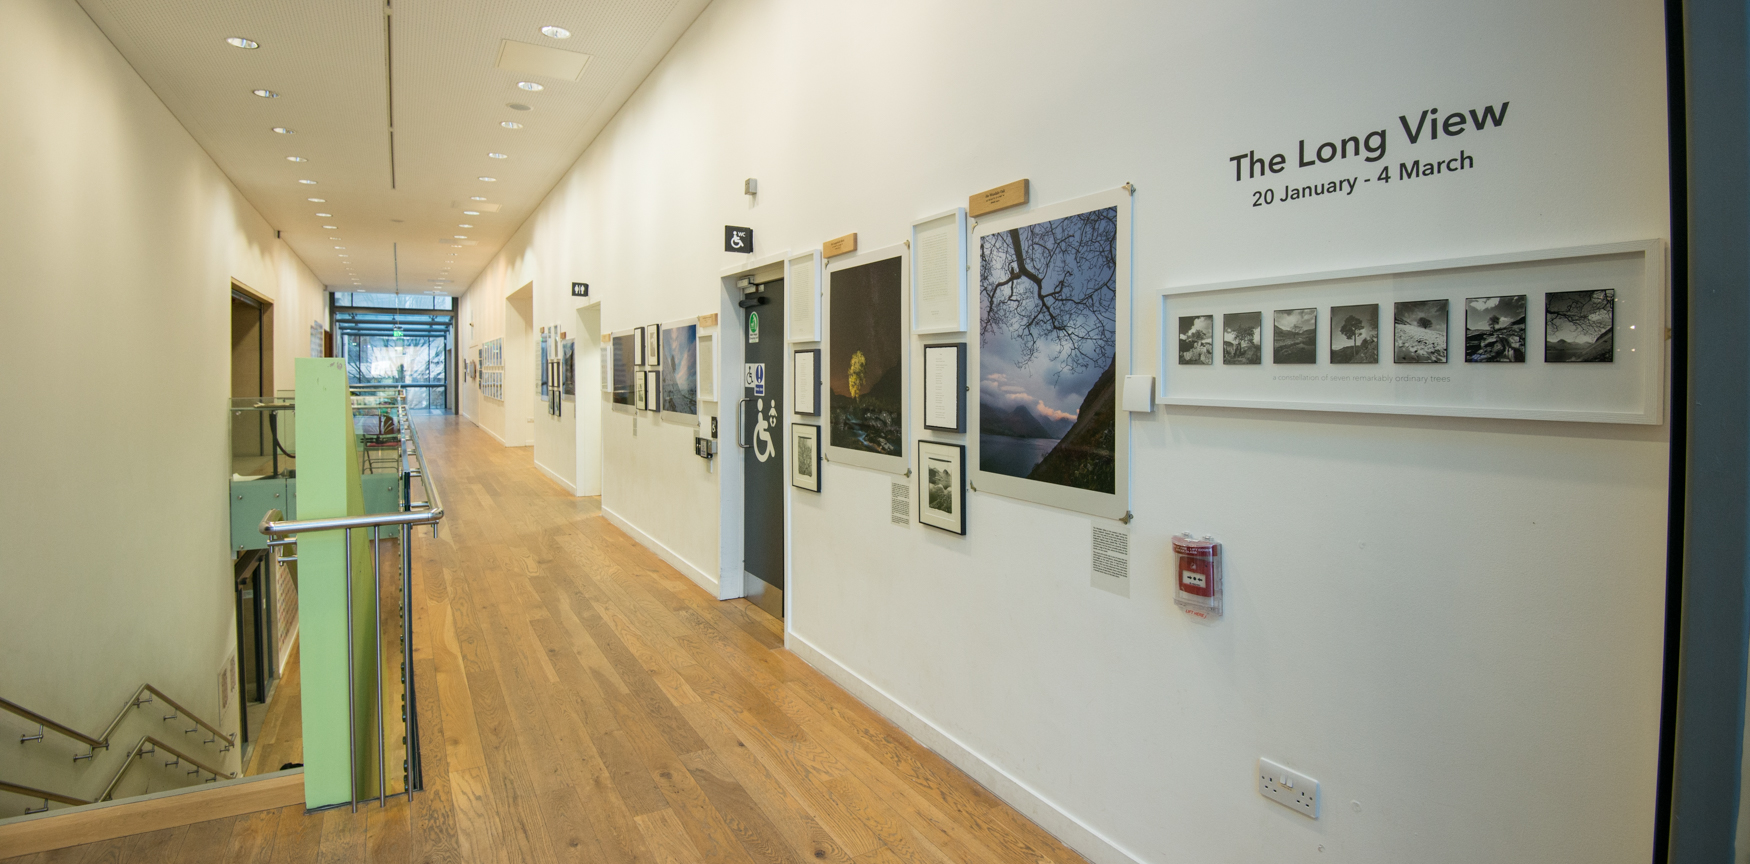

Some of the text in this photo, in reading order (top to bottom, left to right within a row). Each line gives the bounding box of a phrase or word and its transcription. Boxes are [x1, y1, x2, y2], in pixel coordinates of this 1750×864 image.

[1229, 101, 1510, 182] The Long View
[1252, 188, 1275, 207] 20
[1279, 176, 1358, 203] January
[1376, 165, 1392, 184] 4
[1399, 149, 1474, 181] March
[1278, 374, 1320, 382] constellation
[1321, 374, 1329, 382] of
[1352, 374, 1394, 384] remarkably
[1395, 375, 1429, 384] ordinary
[1430, 375, 1451, 383] trees
